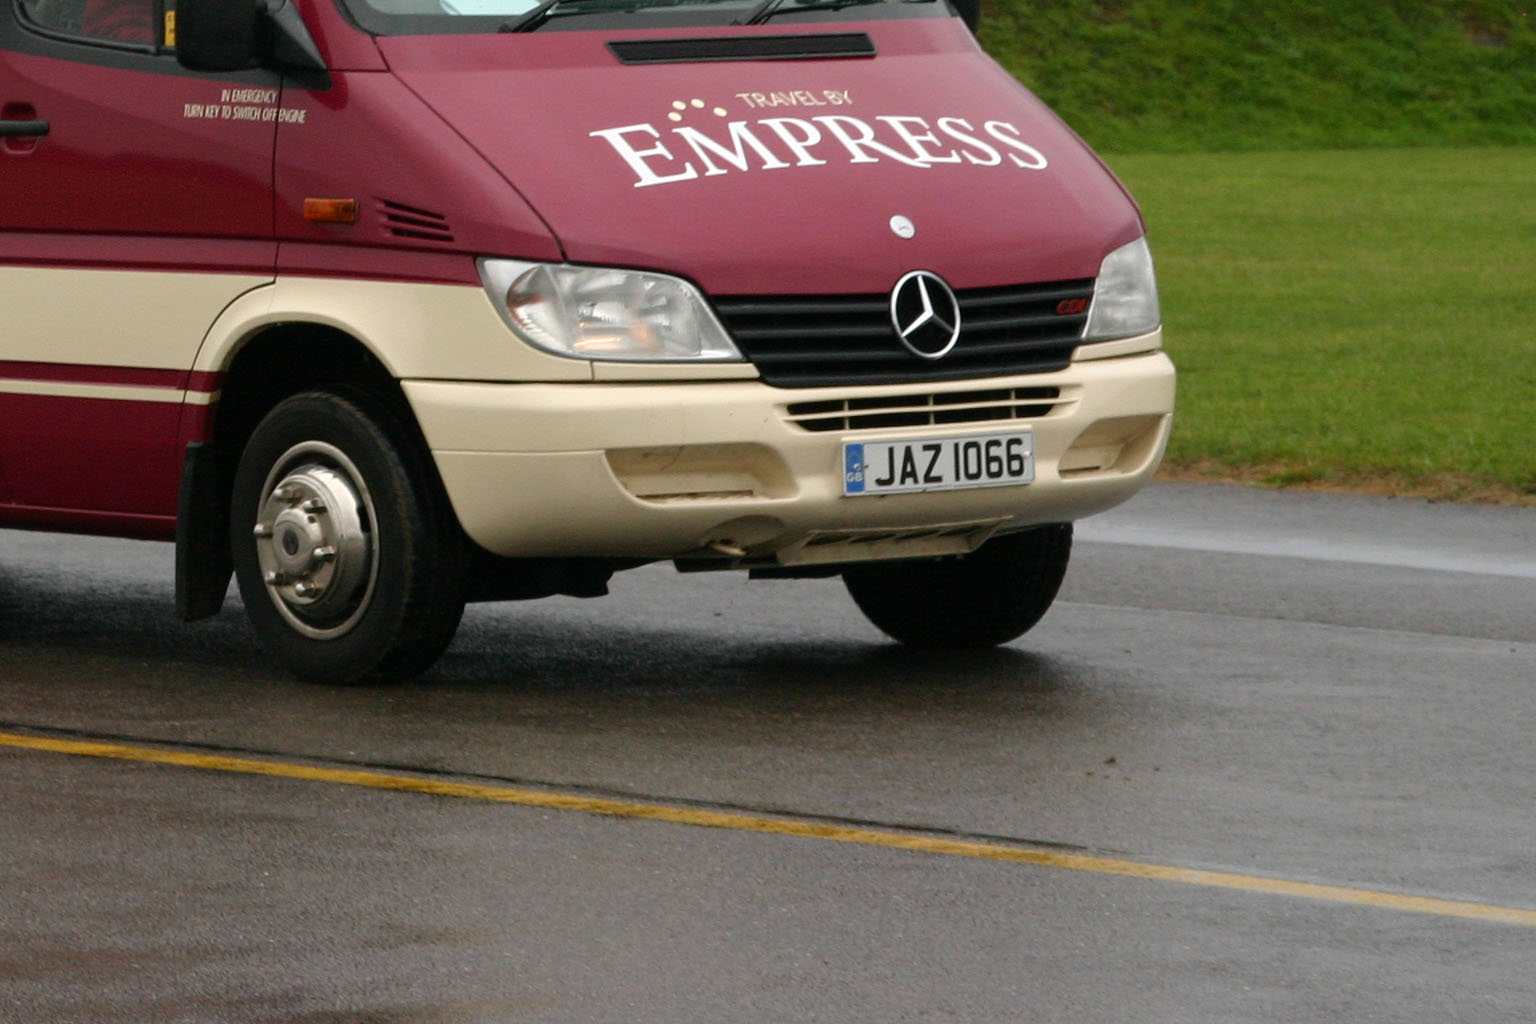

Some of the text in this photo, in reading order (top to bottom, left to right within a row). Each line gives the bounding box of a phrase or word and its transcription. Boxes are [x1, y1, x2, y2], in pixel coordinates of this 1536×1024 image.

[221, 88, 278, 104] IN EMERGENCY
[735, 90, 853, 108] TRAVEL BY
[184, 104, 306, 124] TURN KEY TO SWITCH OFF ENGINE
[589, 114, 1048, 188] EMPRESS
[874, 437, 1025, 487] JAZ 1066
[846, 471, 863, 483] GB
